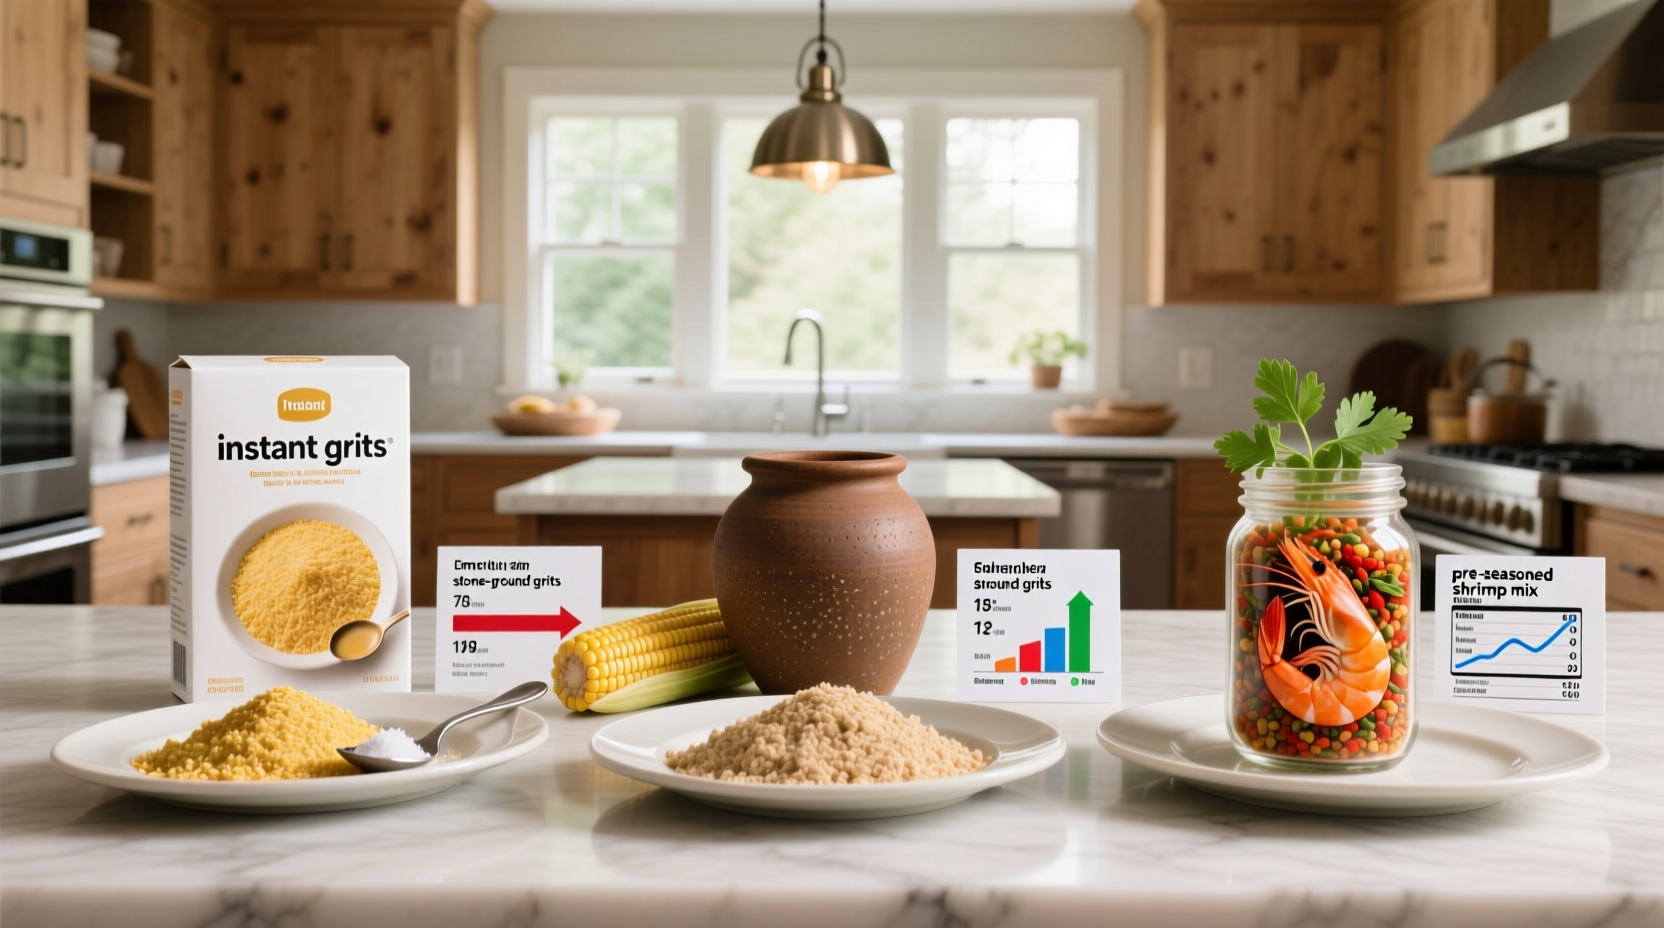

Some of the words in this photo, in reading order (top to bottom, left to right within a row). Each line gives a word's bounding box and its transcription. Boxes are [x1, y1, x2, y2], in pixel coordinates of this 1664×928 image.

[218, 434, 318, 460] instant
[534, 575, 561, 589] grits
[1452, 568, 1553, 584] pre-seasoned
[1023, 577, 1051, 593] grits
[1453, 582, 1507, 600] shrimp
[1512, 583, 1538, 596] mix
